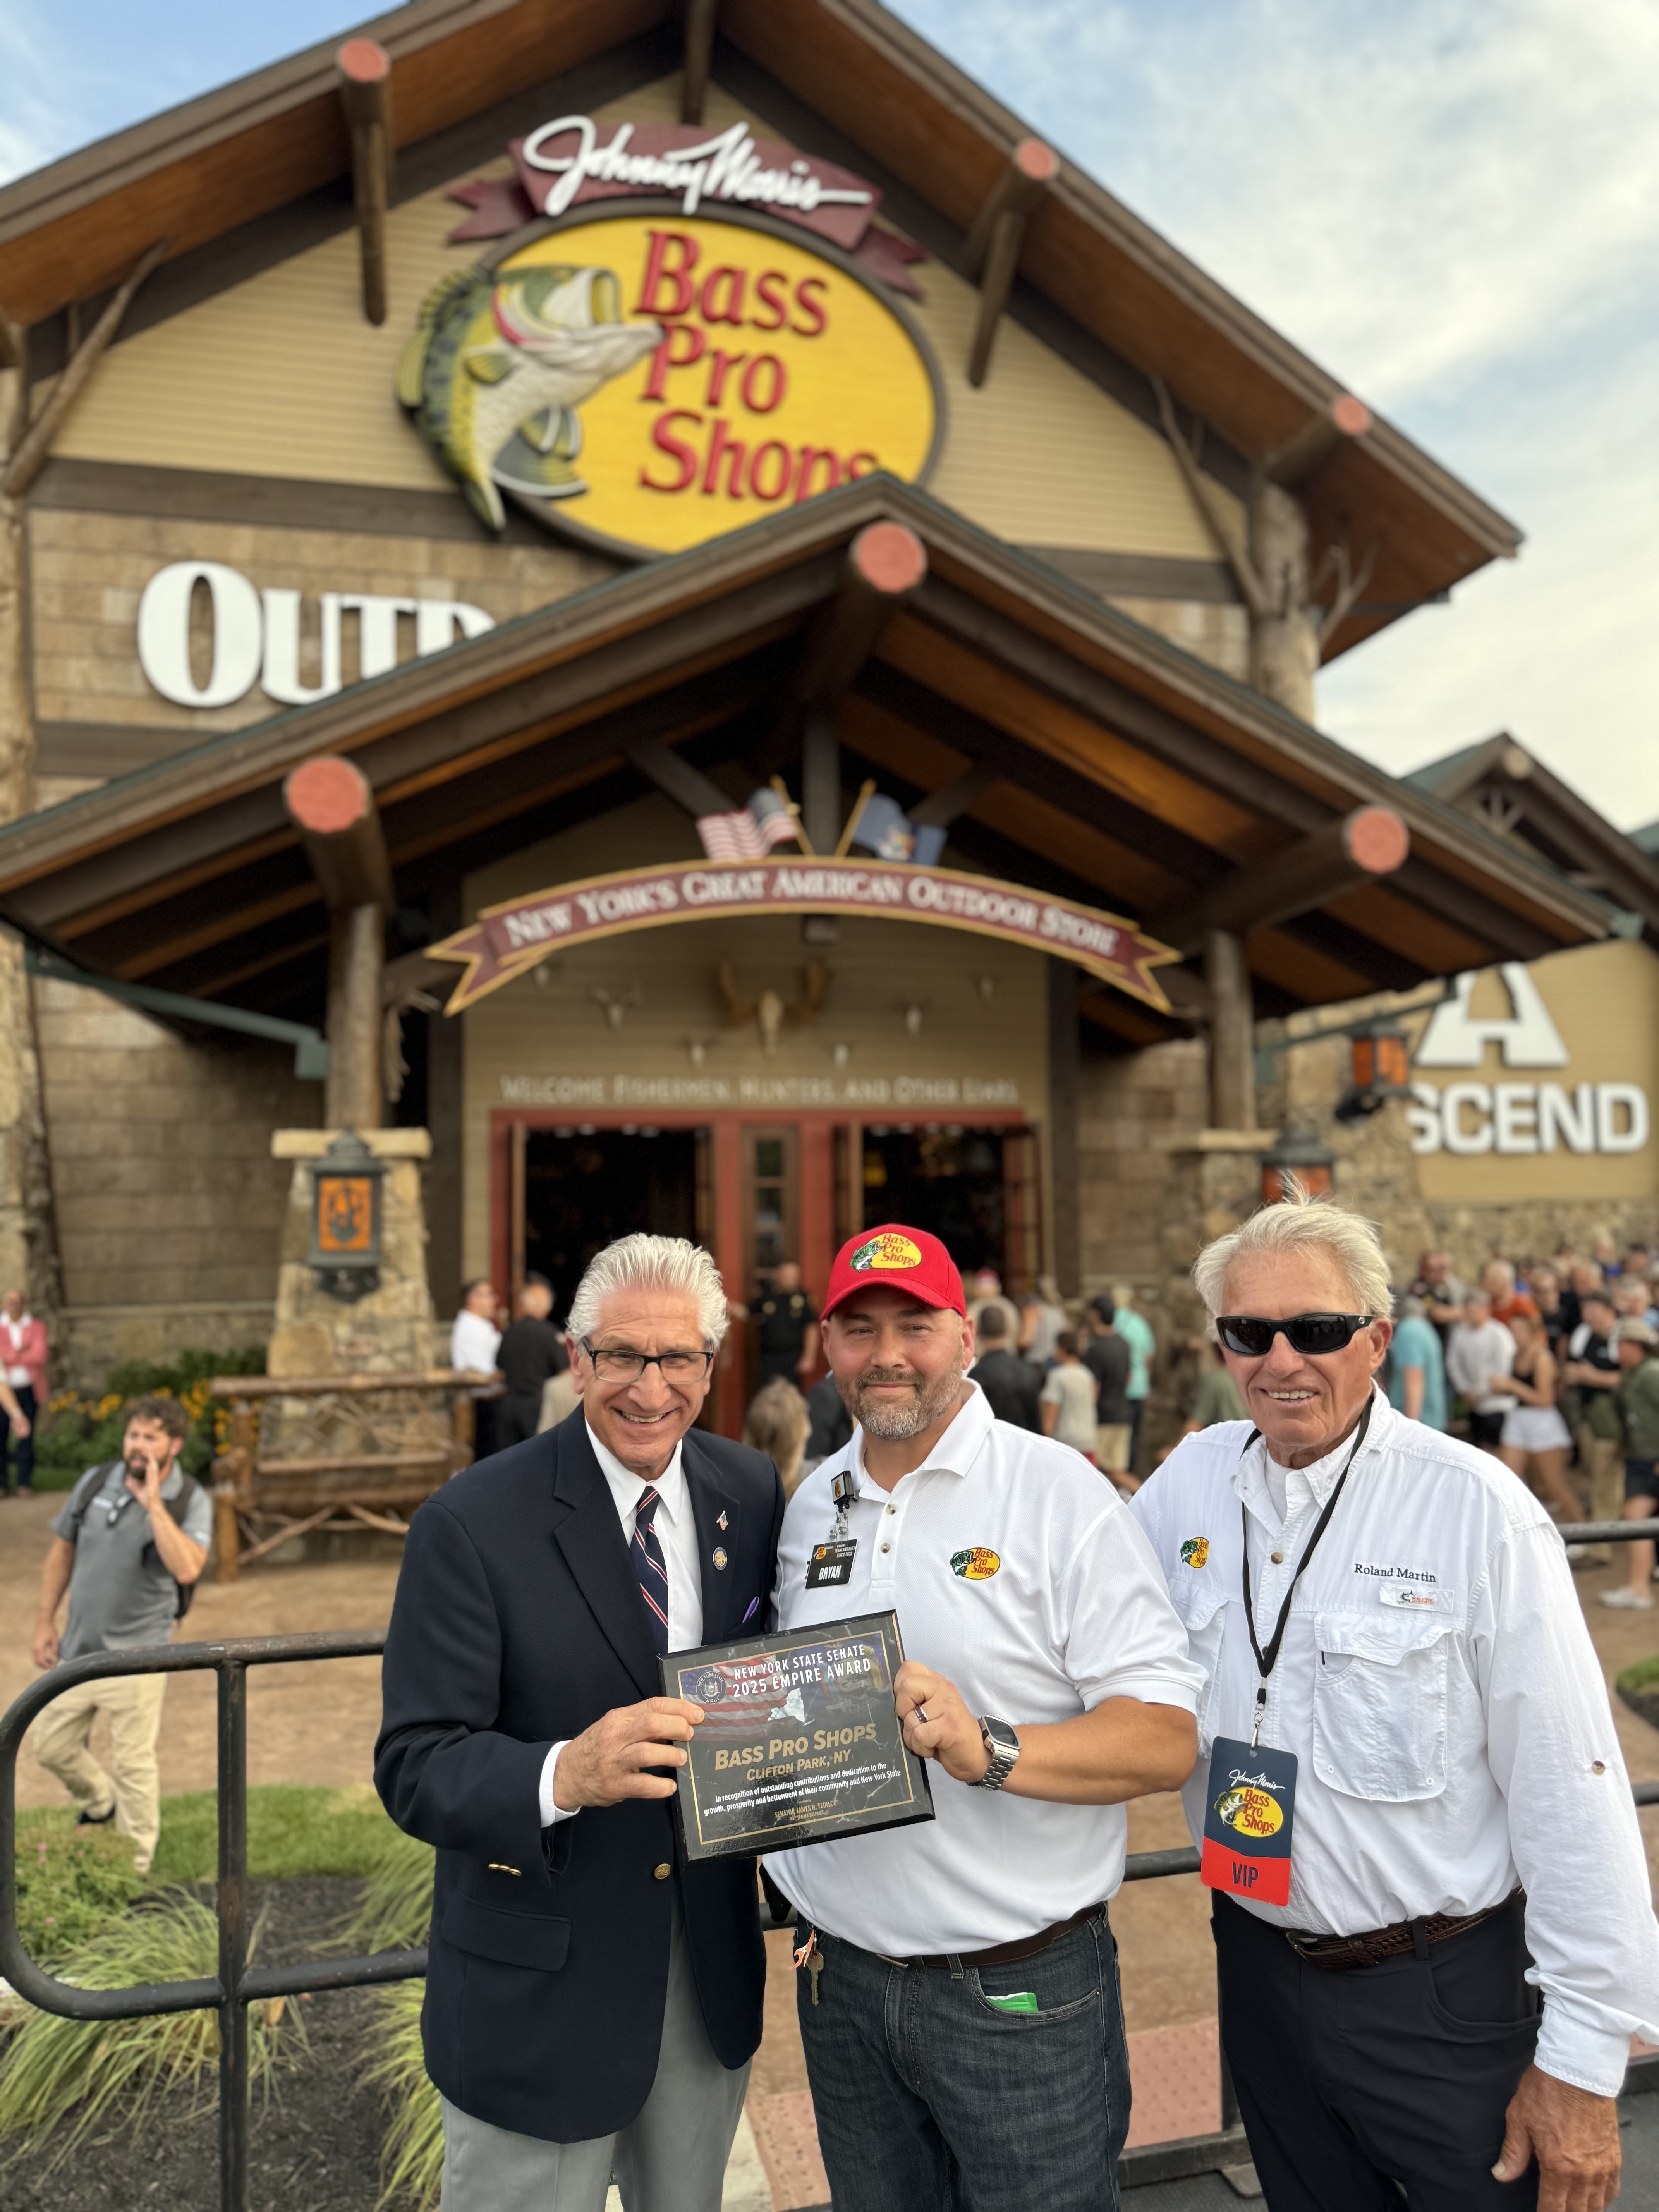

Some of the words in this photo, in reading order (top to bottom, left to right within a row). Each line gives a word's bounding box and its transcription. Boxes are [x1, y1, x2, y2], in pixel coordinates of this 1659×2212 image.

[523, 115, 704, 216] Johnny
[664, 122, 873, 211] Morris
[634, 228, 830, 339] Bass
[637, 322, 788, 414] Pro
[503, 902, 572, 948] NEW
[577, 879, 679, 925] YORK'S
[681, 869, 768, 905] GREAT
[772, 867, 903, 905] AMERICAN
[908, 874, 1039, 931] OUTDOOR
[1039, 905, 1120, 957] STORE
[881, 1234, 910, 1246] Bass
[882, 1243, 903, 1253] Pro
[881, 1252, 916, 1266] Shops
[973, 1557, 988, 1565] Pro
[974, 1548, 993, 1558] Bass
[818, 1565, 842, 1580] BRYAN
[971, 1565, 995, 1576] Shops
[1354, 1563, 1393, 1577] Roland
[1396, 1567, 1436, 1582] Martin
[734, 1666, 756, 1680] NEW
[760, 1659, 789, 1674] YORK
[793, 1652, 823, 1669] STATE
[826, 1644, 865, 1662] SENATE
[732, 1679, 767, 1697] 2025
[772, 1668, 821, 1690] EMPIRE
[827, 1658, 871, 1679] AWARD
[715, 1745, 764, 1771] BASS
[769, 1736, 809, 1759] PRO
[814, 1723, 876, 1750] SHOPS
[747, 1762, 793, 1781] CLIFTON
[797, 1755, 830, 1772] PARK,
[834, 1749, 851, 1764] NY
[722, 1789, 753, 1802] recognition
[754, 1787, 760, 1795] of
[760, 1781, 793, 1794] outstanding
[793, 1774, 830, 1787] contributions
[830, 1771, 841, 1780] and
[842, 1766, 870, 1776] dedication
[1229, 1769, 1257, 1789] Johnny
[1255, 1772, 1285, 1790] Morris
[726, 1799, 755, 1812] prosperity
[756, 1796, 766, 1805] and
[767, 1790, 797, 1803] betterment
[805, 1786, 817, 1795] their
[819, 1781, 849, 1792] community
[850, 1778, 860, 1786] and
[861, 1775, 873, 1783] New
[874, 1772, 886, 1781] York
[887, 1770, 901, 1778] State
[1243, 1788, 1269, 1807] Bass
[775, 1808, 795, 1818] SENATOR
[796, 1805, 811, 1814] JAMES
[818, 1800, 837, 1809] TEDISCO
[1243, 1803, 1263, 1817] Pro
[1242, 1814, 1274, 1835] Shops
[1233, 1862, 1258, 1888] VIP
